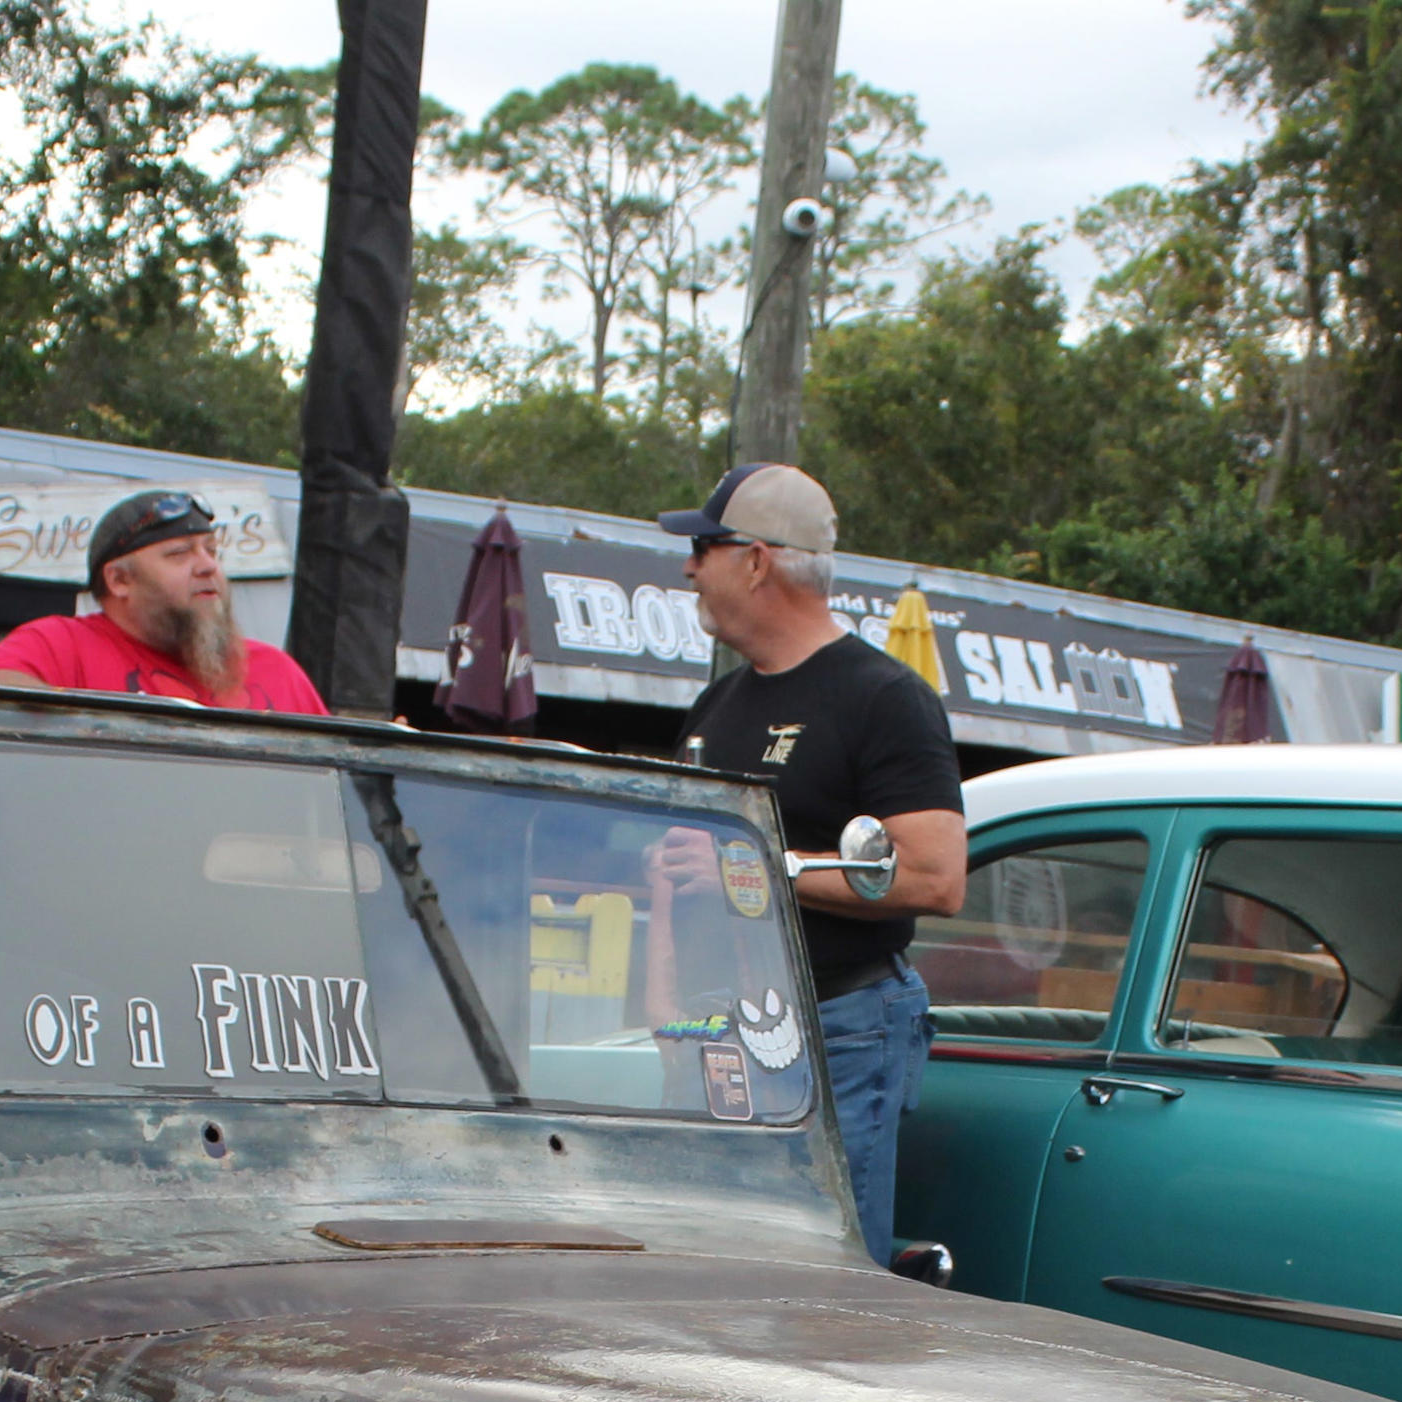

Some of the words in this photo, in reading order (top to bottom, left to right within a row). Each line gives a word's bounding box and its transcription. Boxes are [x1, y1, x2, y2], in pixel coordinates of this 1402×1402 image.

[543, 572, 715, 666] IRON
[25, 993, 99, 1067] OF
[127, 996, 165, 1068] A
[191, 962, 381, 1081] FINK
